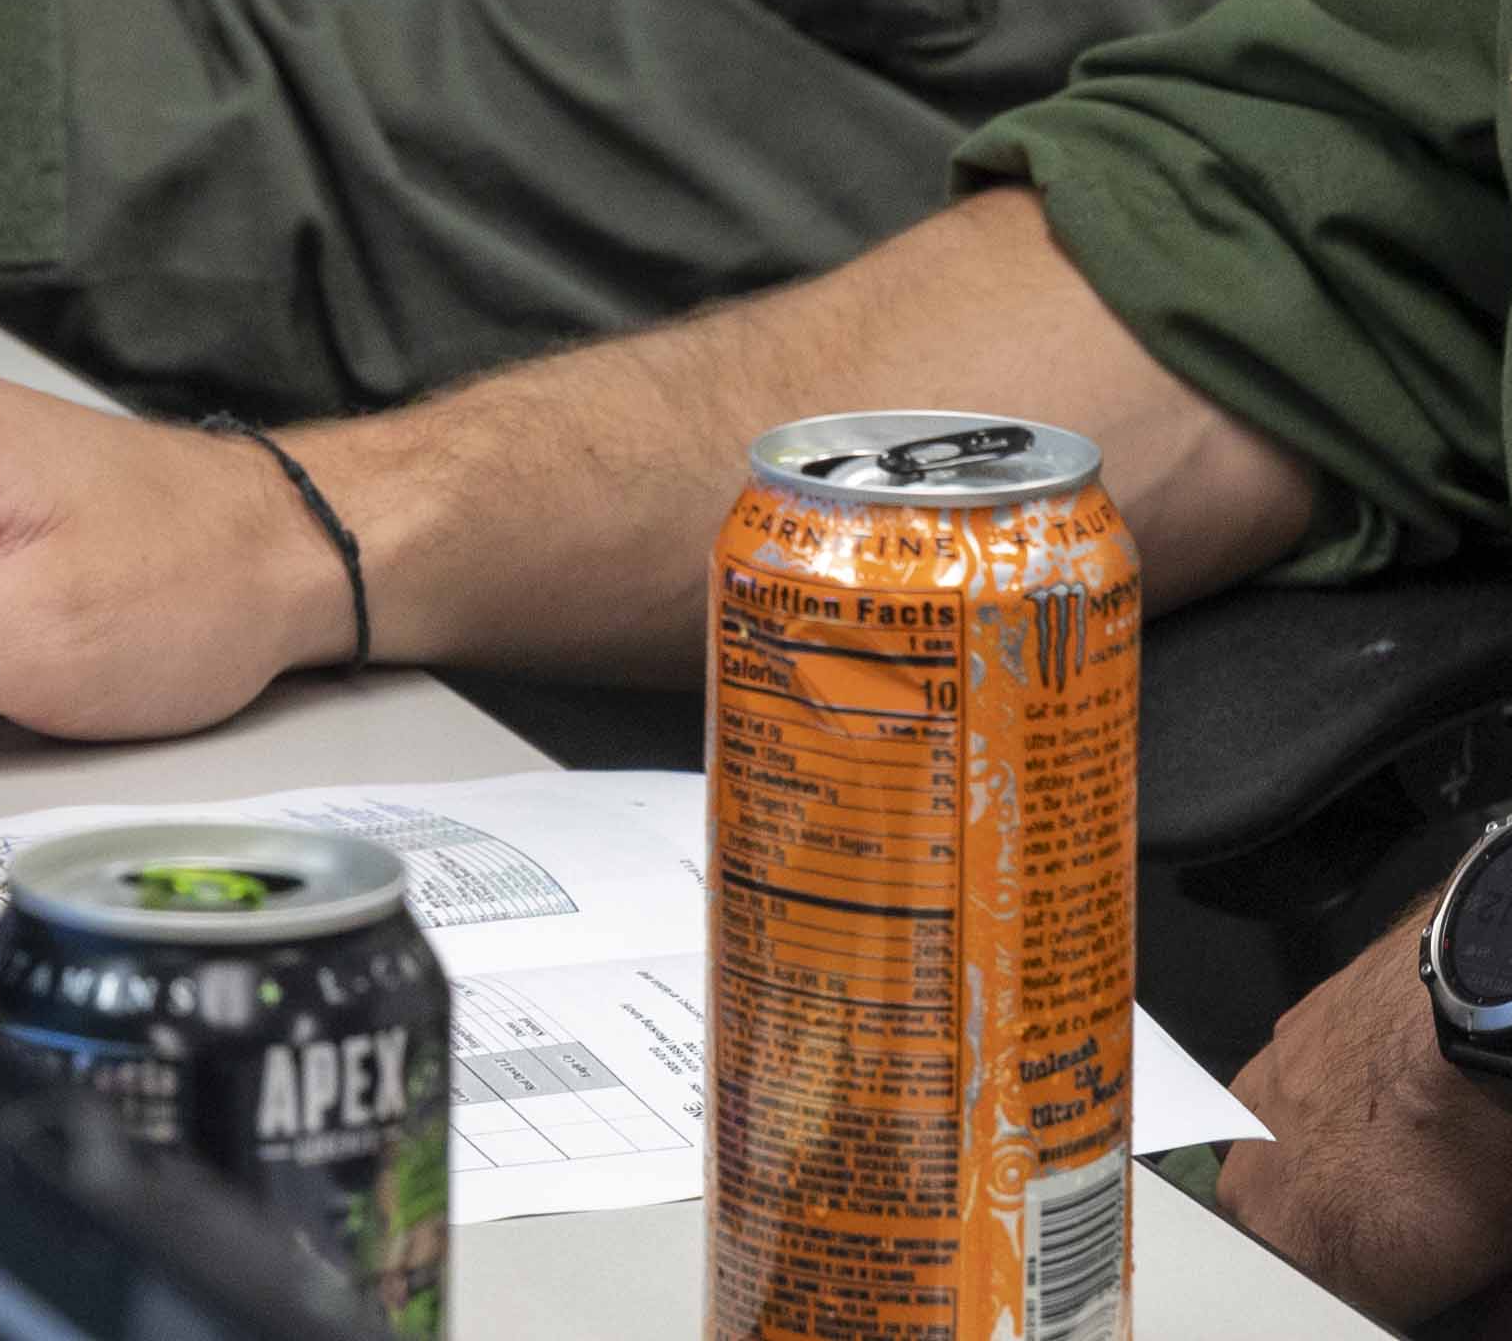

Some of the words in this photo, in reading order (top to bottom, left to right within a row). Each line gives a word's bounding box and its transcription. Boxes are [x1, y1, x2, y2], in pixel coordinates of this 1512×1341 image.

[726, 568, 841, 619] Nutrition
[858, 598, 955, 626] Facts
[923, 680, 958, 712] 10
[256, 1024, 410, 1140] APEX
